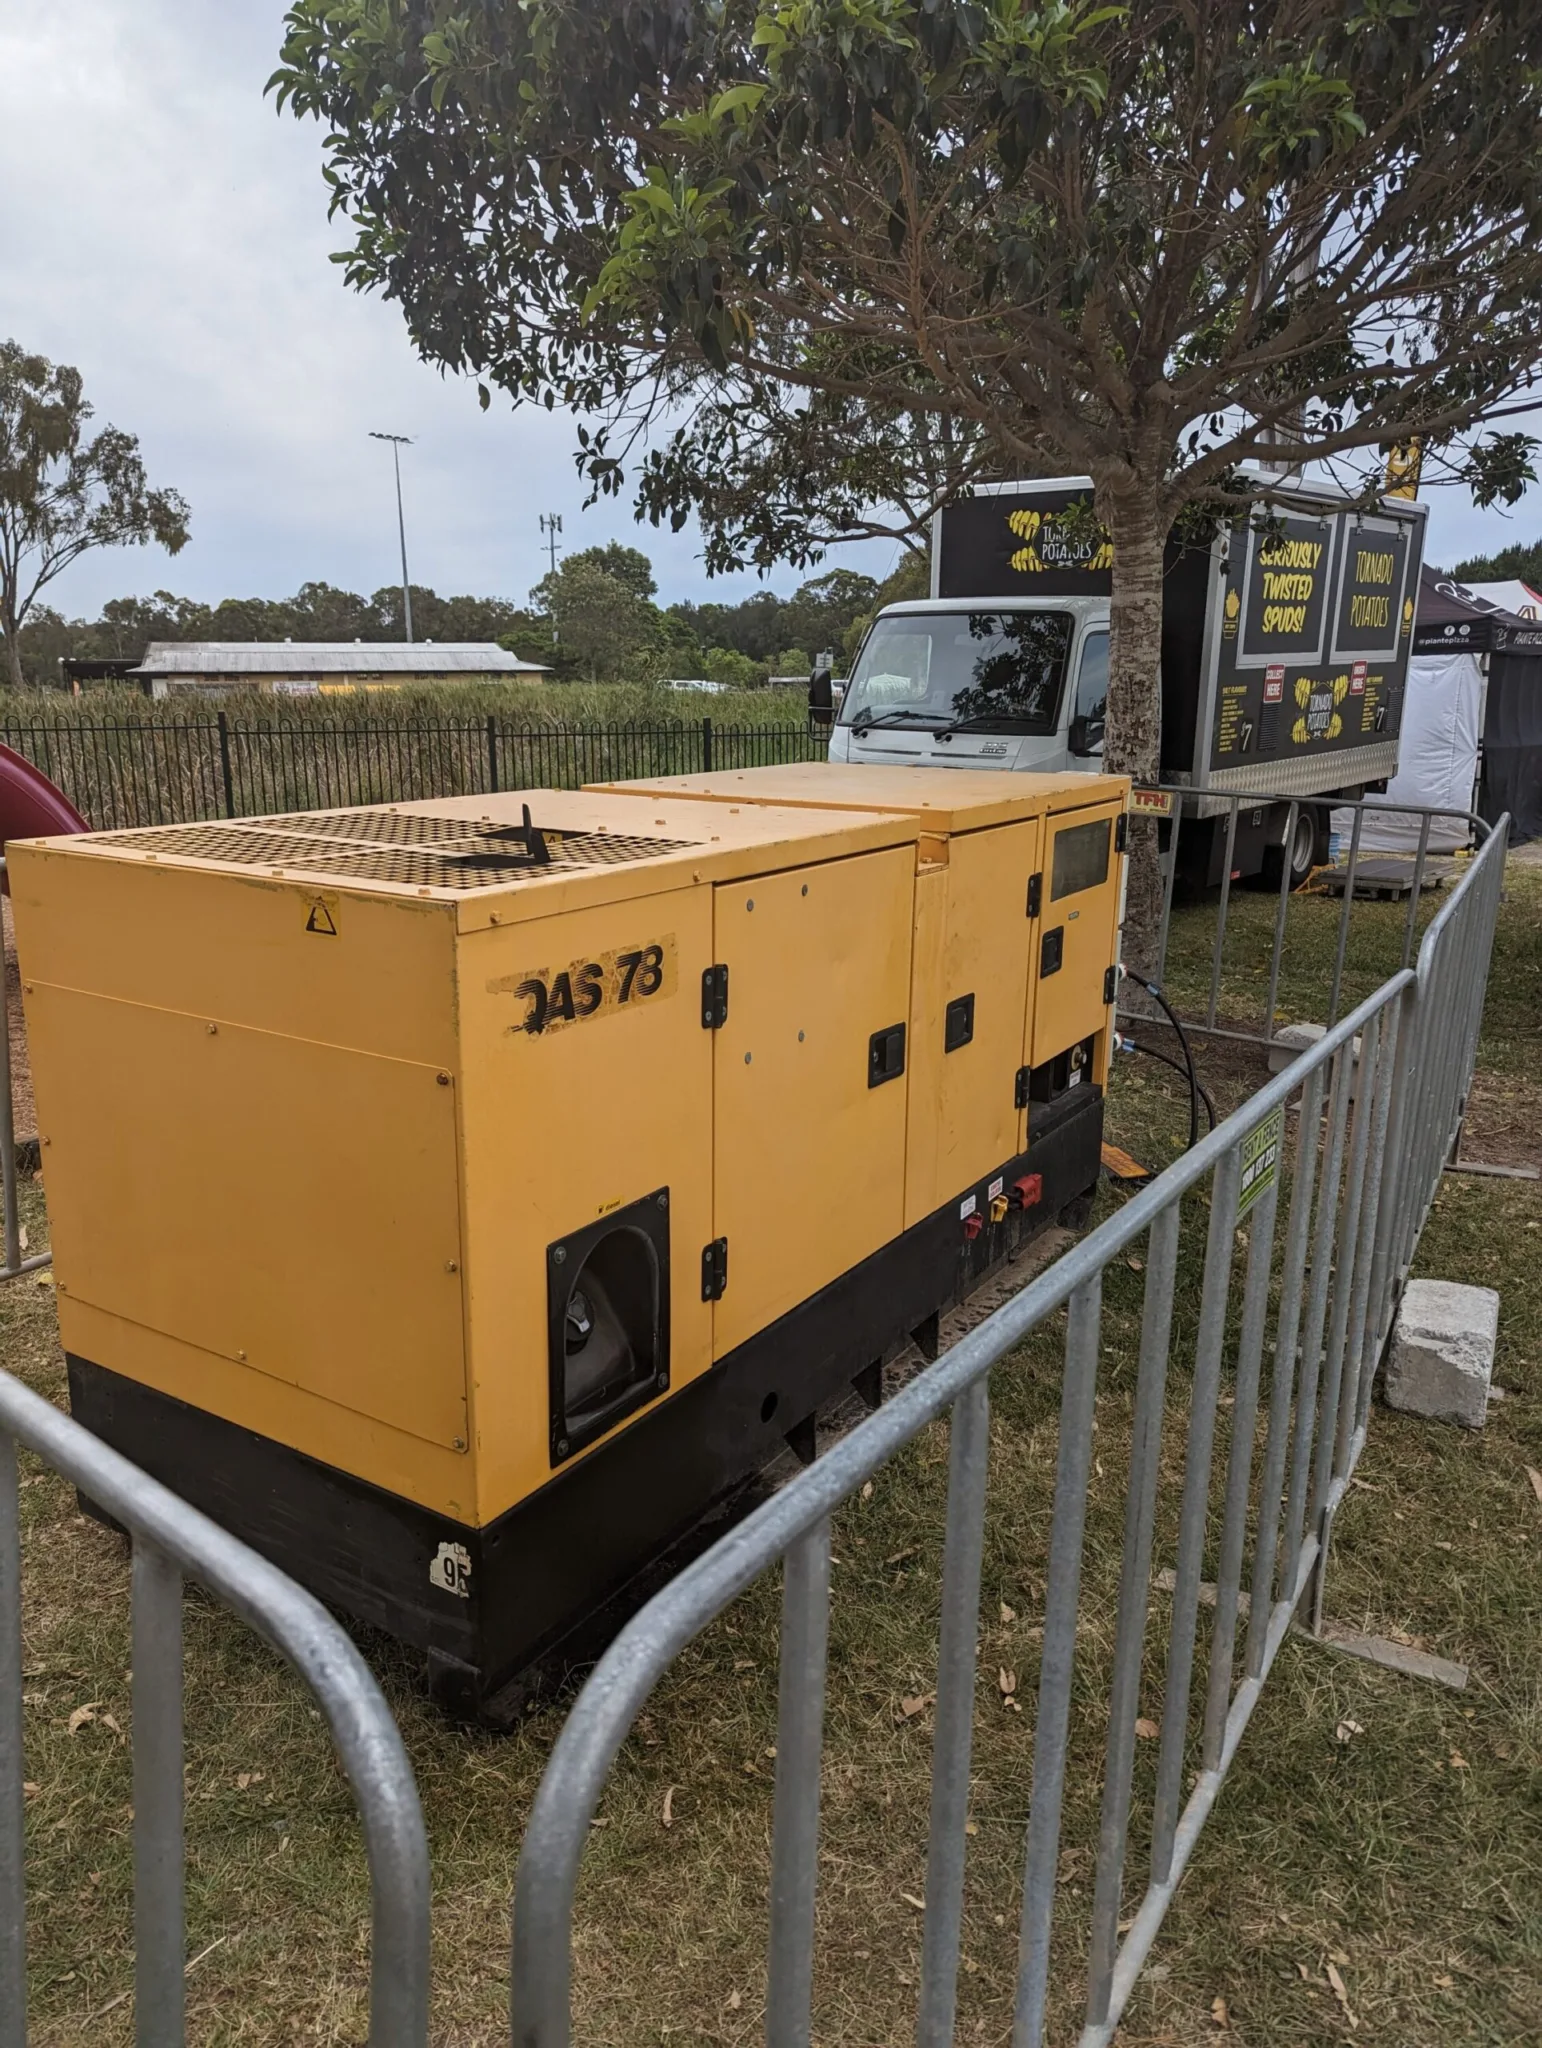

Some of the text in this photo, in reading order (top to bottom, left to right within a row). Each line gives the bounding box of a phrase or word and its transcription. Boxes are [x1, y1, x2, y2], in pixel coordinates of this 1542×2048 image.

[1355, 551, 1394, 585] TORNADO
[1263, 572, 1313, 601] TWISTED
[1262, 605, 1307, 633] SPUDS!
[1350, 595, 1389, 627] POTATOES
[1266, 683, 1281, 697] HERE
[1309, 693, 1333, 712] TORNADO
[1307, 711, 1331, 731] POTATOES
[1241, 721, 1253, 751] $7
[1134, 791, 1169, 809] TFH
[616, 944, 664, 1004] 78
